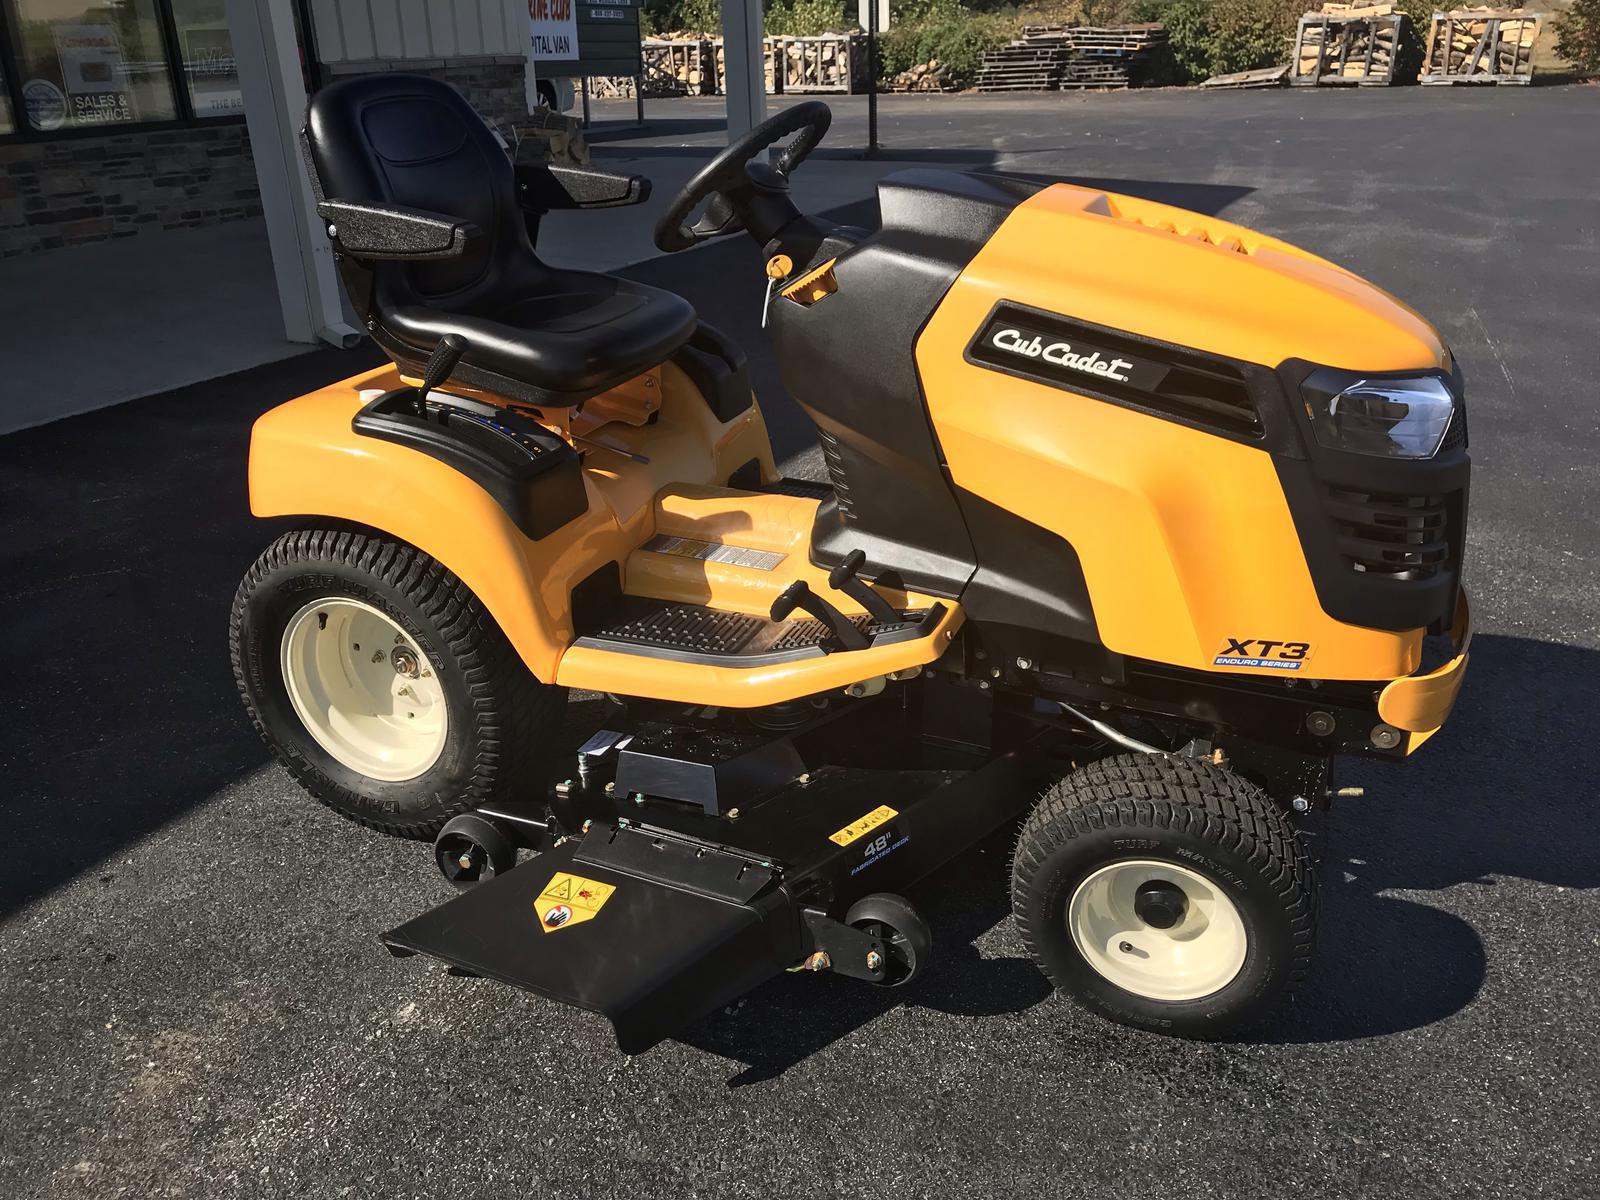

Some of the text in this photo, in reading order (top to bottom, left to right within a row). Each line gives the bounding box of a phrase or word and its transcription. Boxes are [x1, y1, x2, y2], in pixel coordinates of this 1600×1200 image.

[554, 36, 570, 54] VAN
[75, 95, 116, 109] SALES
[118, 94, 128, 107] &
[78, 108, 131, 123] SERVICE
[992, 329, 1133, 382] Cub Cadet
[1219, 638, 1310, 660] XT3
[1216, 658, 1297, 669] ENDURO SERIES
[850, 835, 910, 876] FABRICATED DECK
